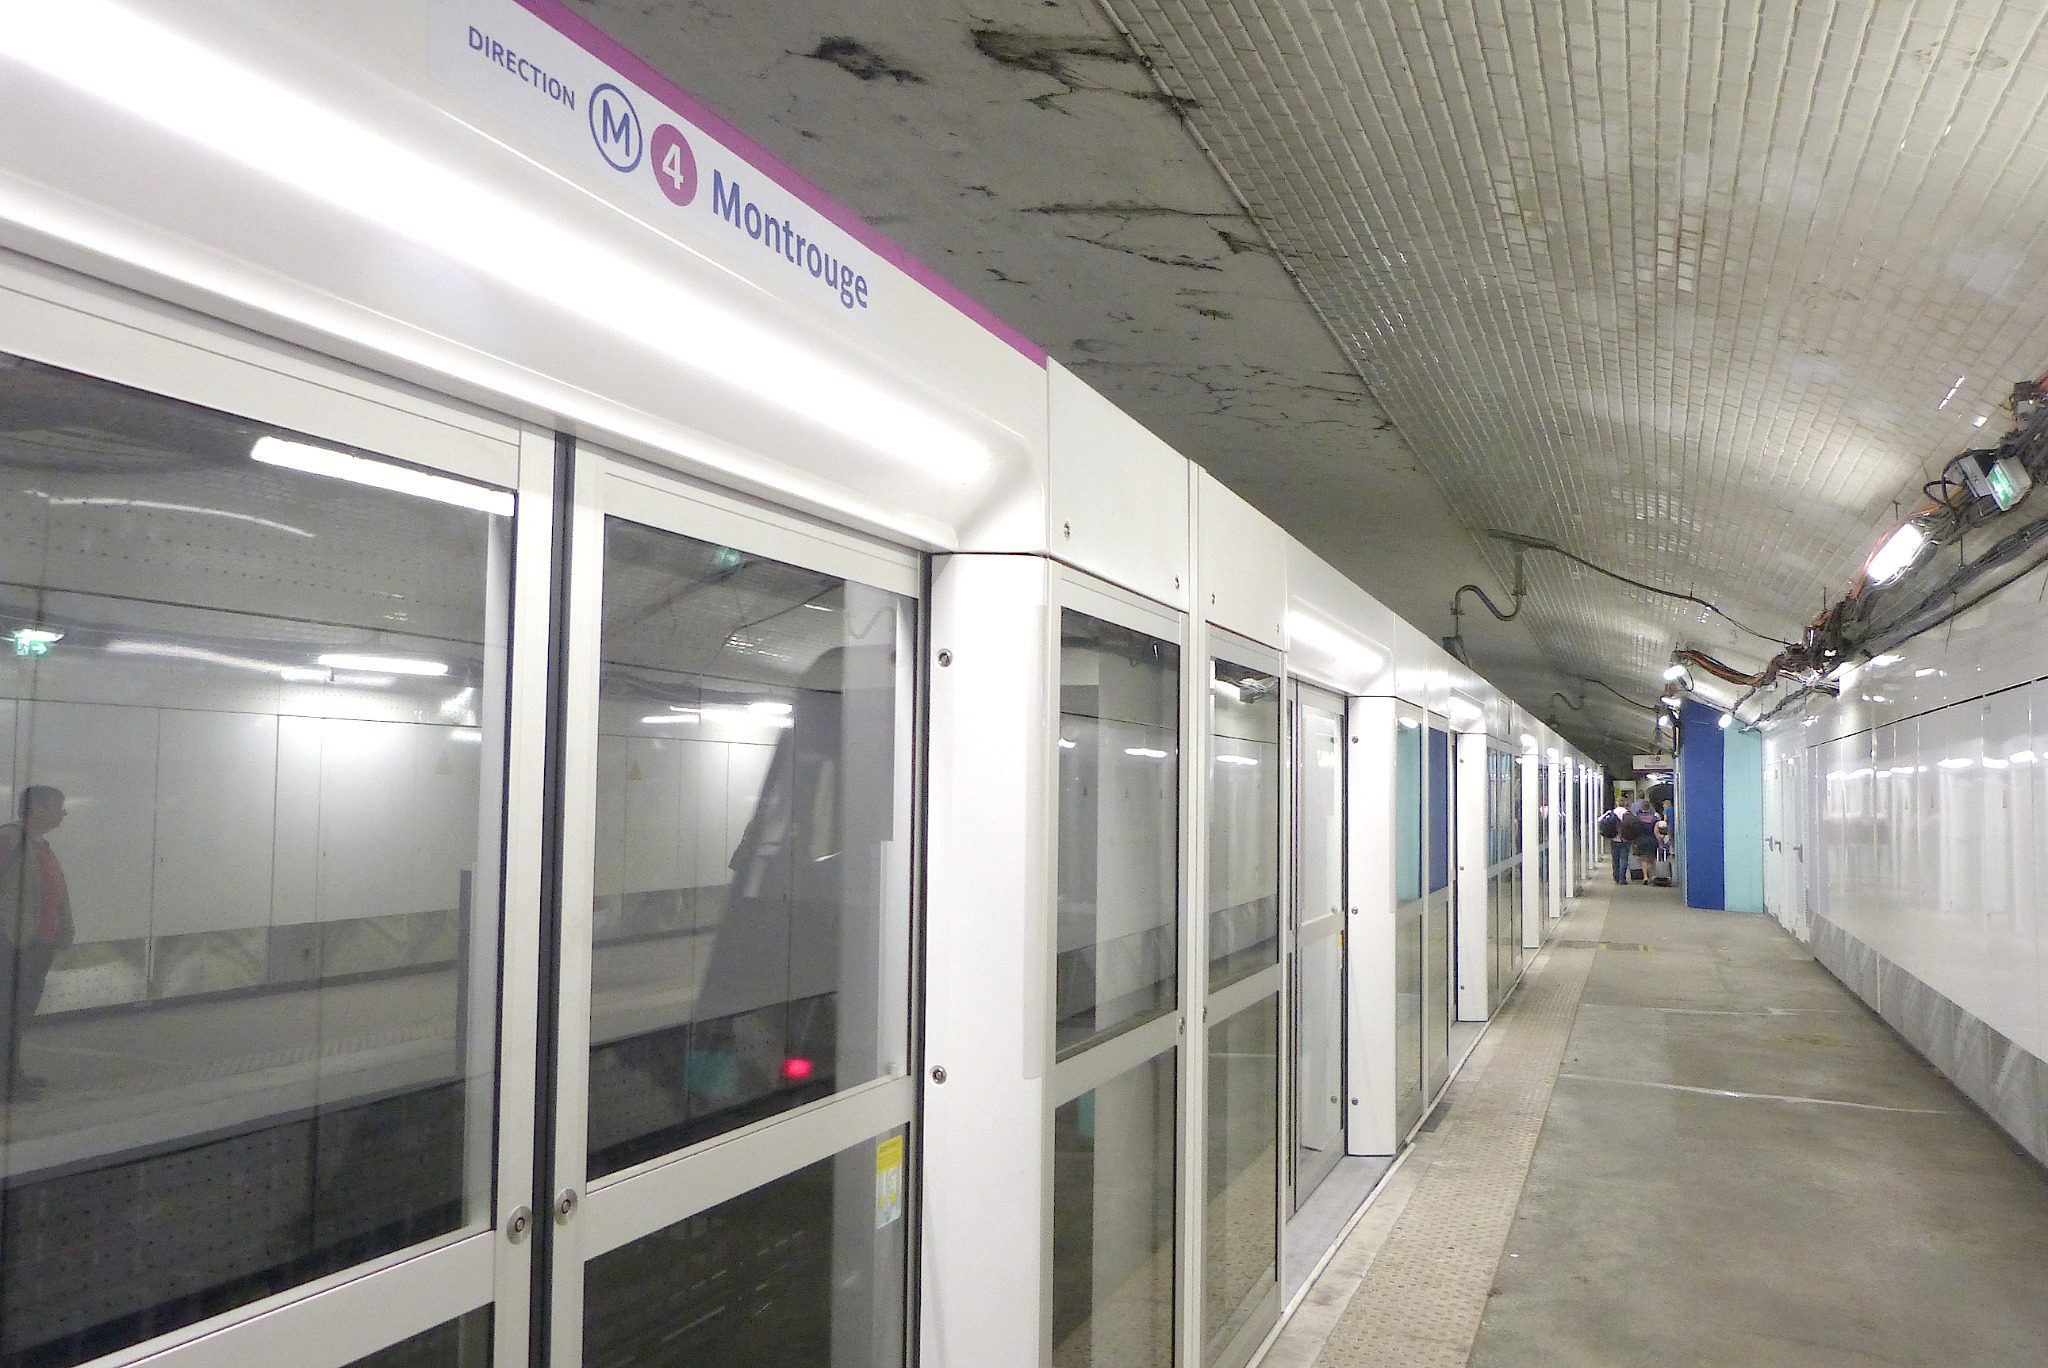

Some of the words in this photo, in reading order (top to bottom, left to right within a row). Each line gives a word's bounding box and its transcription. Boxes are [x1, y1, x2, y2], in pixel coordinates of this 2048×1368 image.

[469, 26, 575, 110] DIRECTION
[602, 99, 631, 158] M
[662, 144, 684, 190] 4
[713, 169, 869, 309] Montrouge
